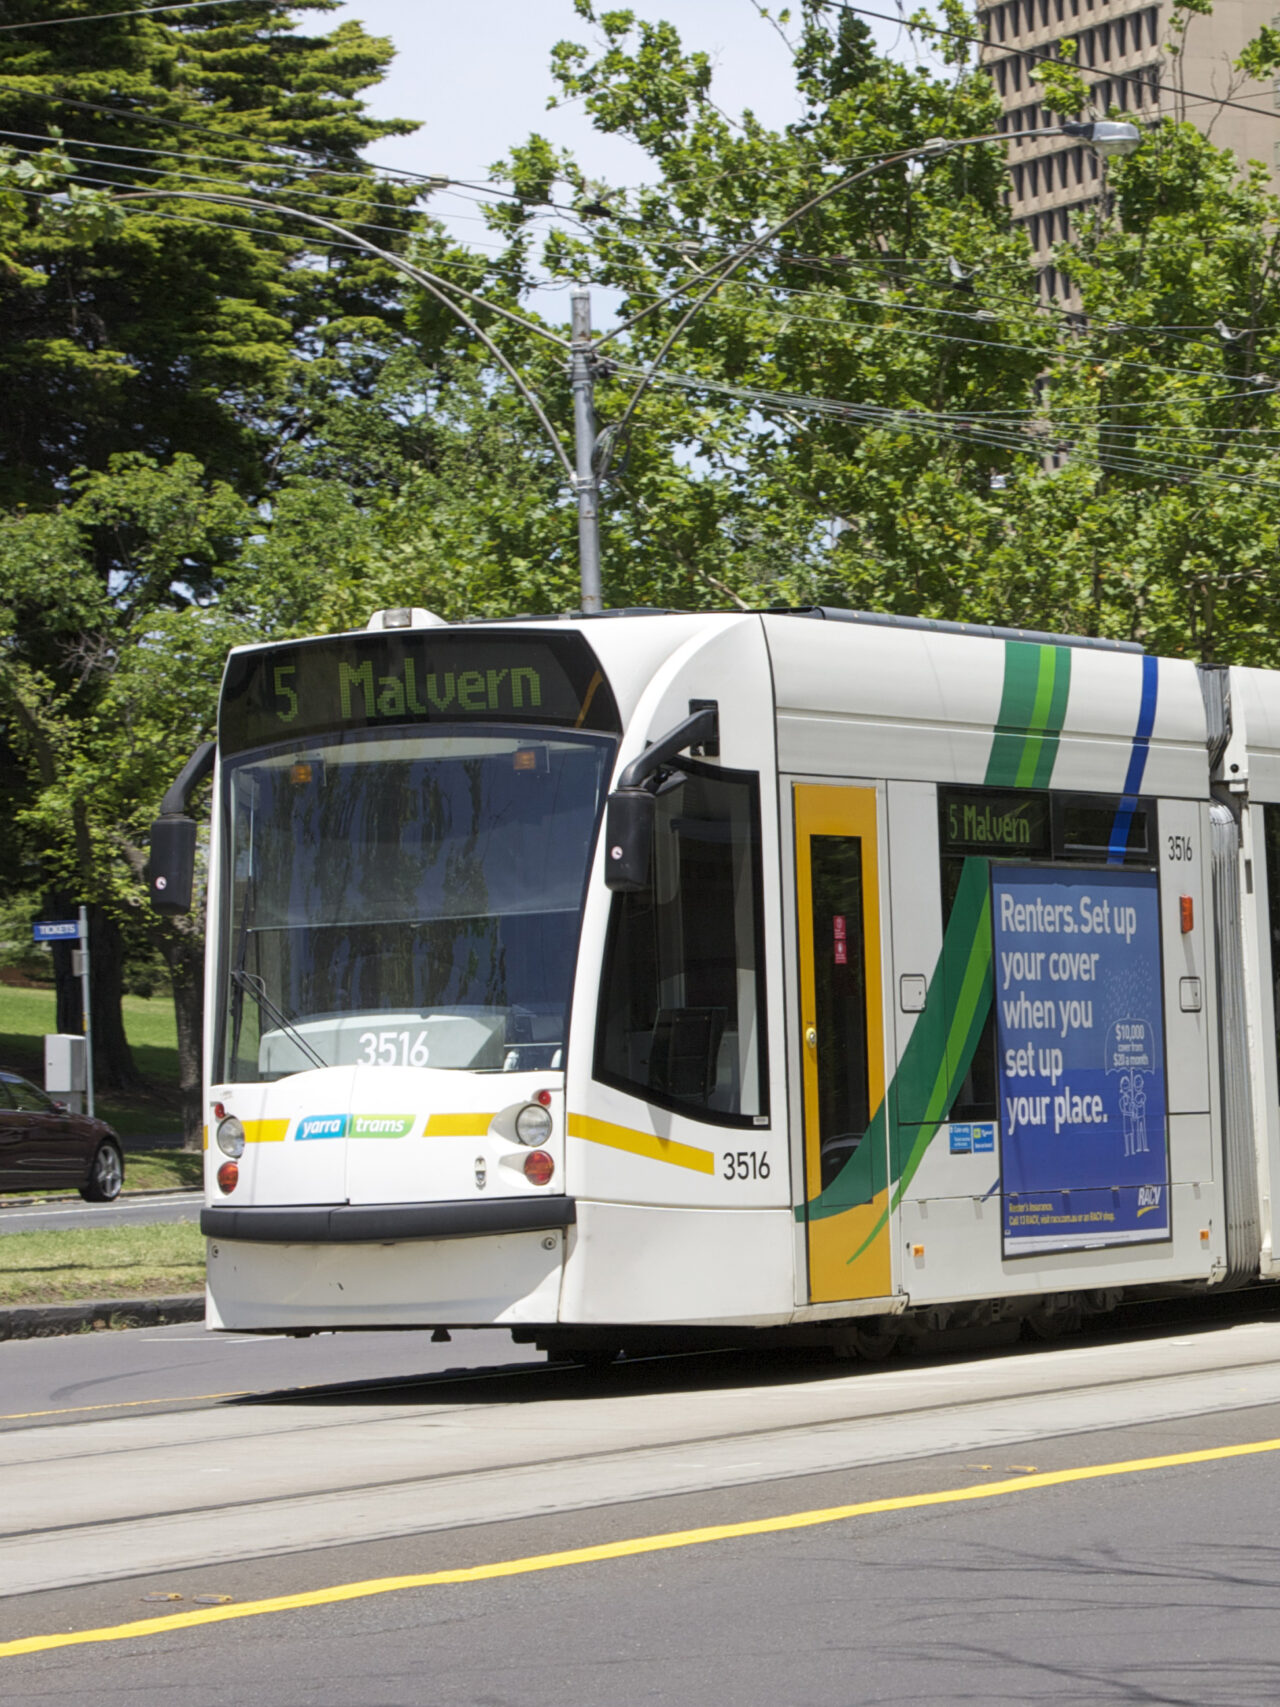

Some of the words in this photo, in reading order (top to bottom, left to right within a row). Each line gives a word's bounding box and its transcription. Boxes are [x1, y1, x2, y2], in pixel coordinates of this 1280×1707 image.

[274, 665, 298, 722] 5
[338, 657, 541, 718] Malvern
[949, 804, 958, 839] 5
[963, 804, 1030, 843] Malvern
[1168, 836, 1192, 861] 3516
[1001, 893, 1078, 933] Renters.
[1080, 895, 1111, 934] Set
[1113, 907, 1136, 944] up
[1001, 952, 1046, 990] your
[1049, 952, 1100, 981] cover
[1003, 991, 1056, 1029] when
[1059, 1000, 1093, 1038] you
[1115, 1023, 1145, 1041] $10,000
[356, 1031, 430, 1067] 3516
[1005, 1041, 1035, 1077] set
[1039, 1048, 1063, 1086] up
[1130, 1053, 1149, 1065] month
[302, 1119, 341, 1138] yarra
[355, 1117, 405, 1133] trams
[1006, 1096, 1050, 1135] your
[1054, 1086, 1108, 1134] place.
[723, 1151, 771, 1180] 3516
[1138, 1186, 1161, 1206] RACV
